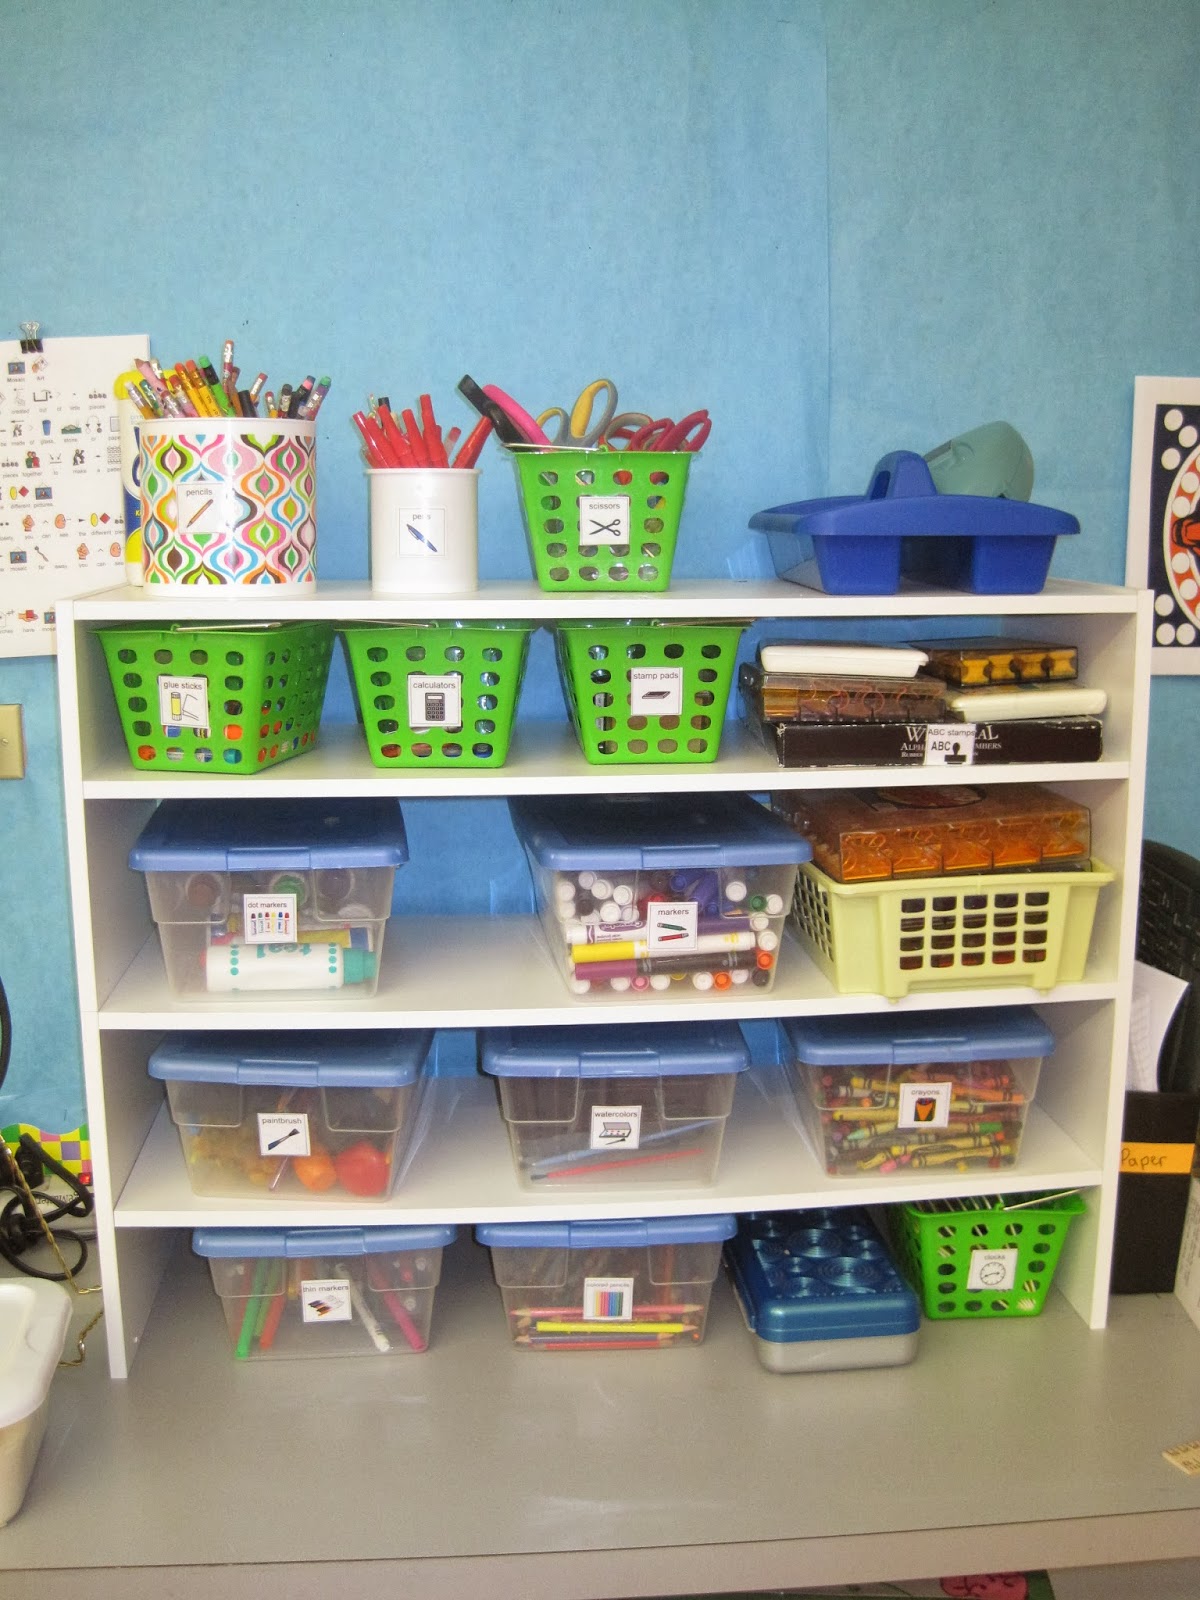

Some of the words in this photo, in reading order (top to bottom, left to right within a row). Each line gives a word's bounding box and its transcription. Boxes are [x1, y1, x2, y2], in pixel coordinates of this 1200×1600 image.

[186, 489, 213, 497] pencils
[660, 672, 679, 680] pads
[163, 681, 180, 690] glue
[181, 682, 203, 690] sticks
[412, 681, 456, 689] calculators
[947, 729, 976, 737] stamps
[931, 741, 951, 750] ABC
[1121, 1147, 1168, 1170] Paper
